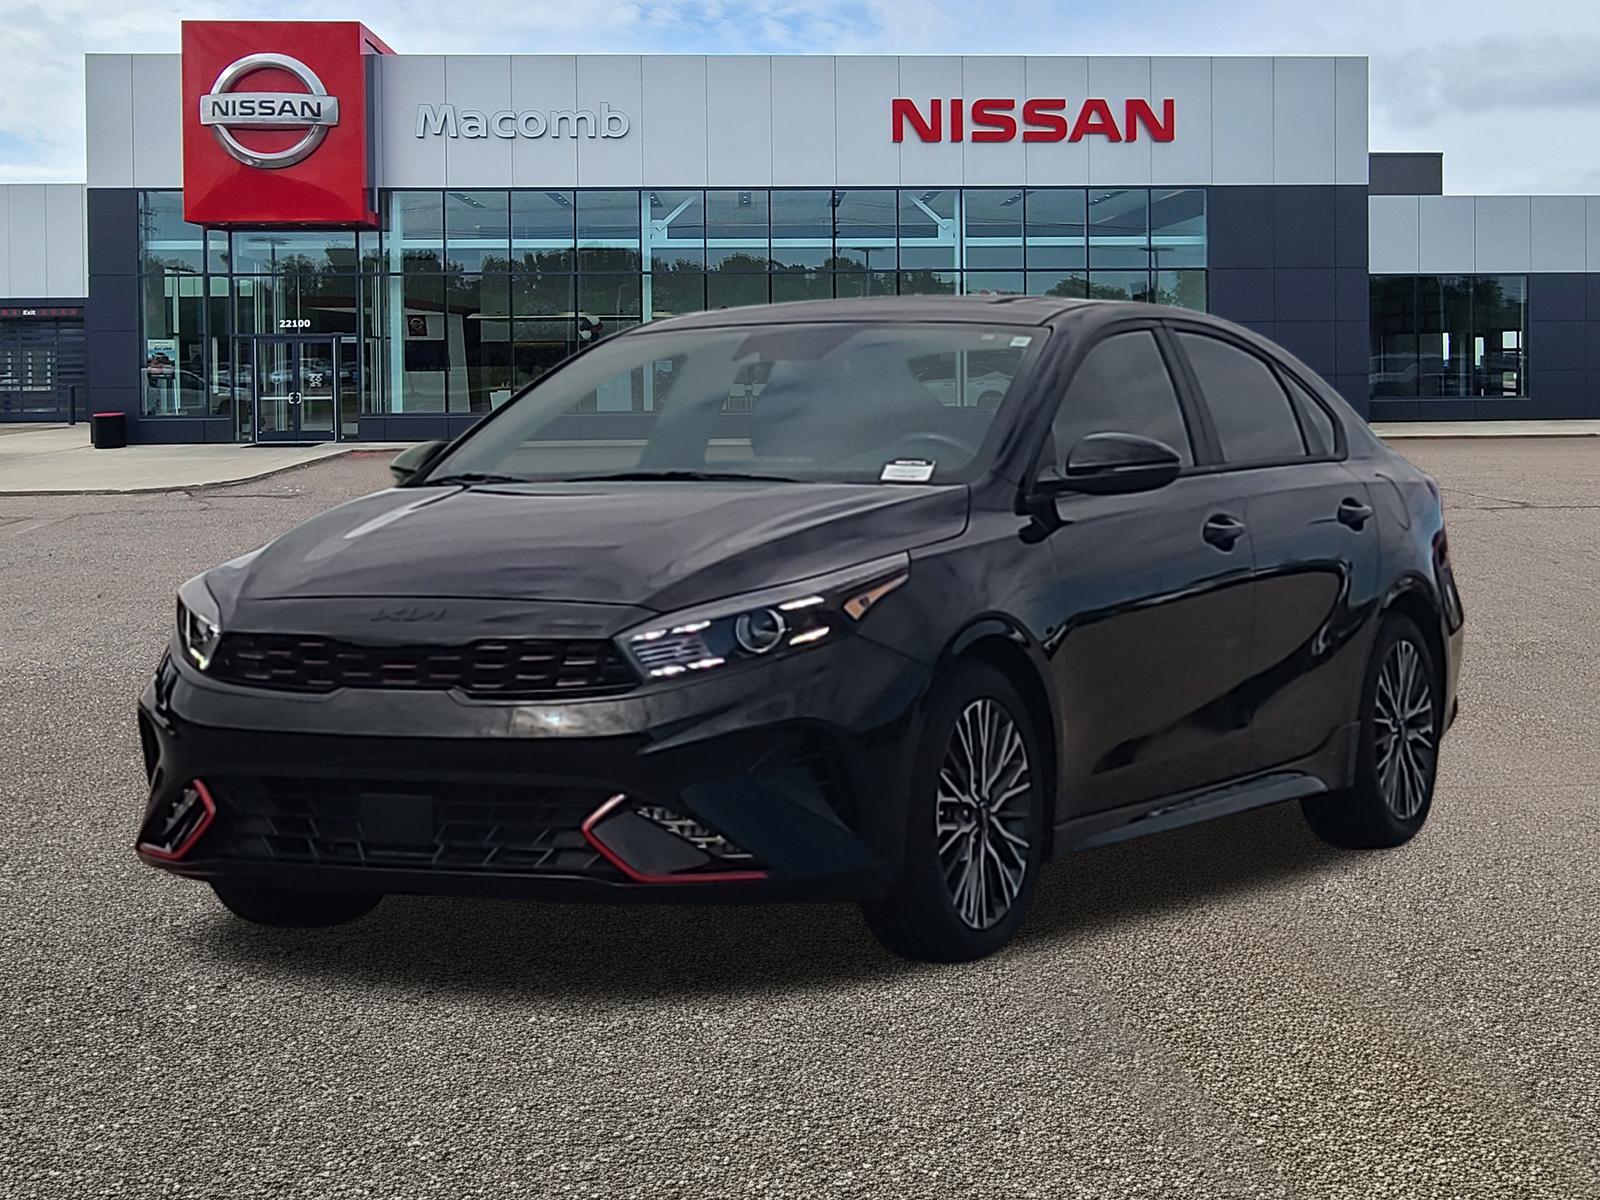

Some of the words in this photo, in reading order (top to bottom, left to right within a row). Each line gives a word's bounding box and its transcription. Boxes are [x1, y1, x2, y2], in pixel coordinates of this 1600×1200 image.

[211, 100, 322, 118] NISSAN
[415, 102, 630, 139] Macomb
[892, 98, 1175, 143] NISSAN
[279, 319, 311, 328] 22100
